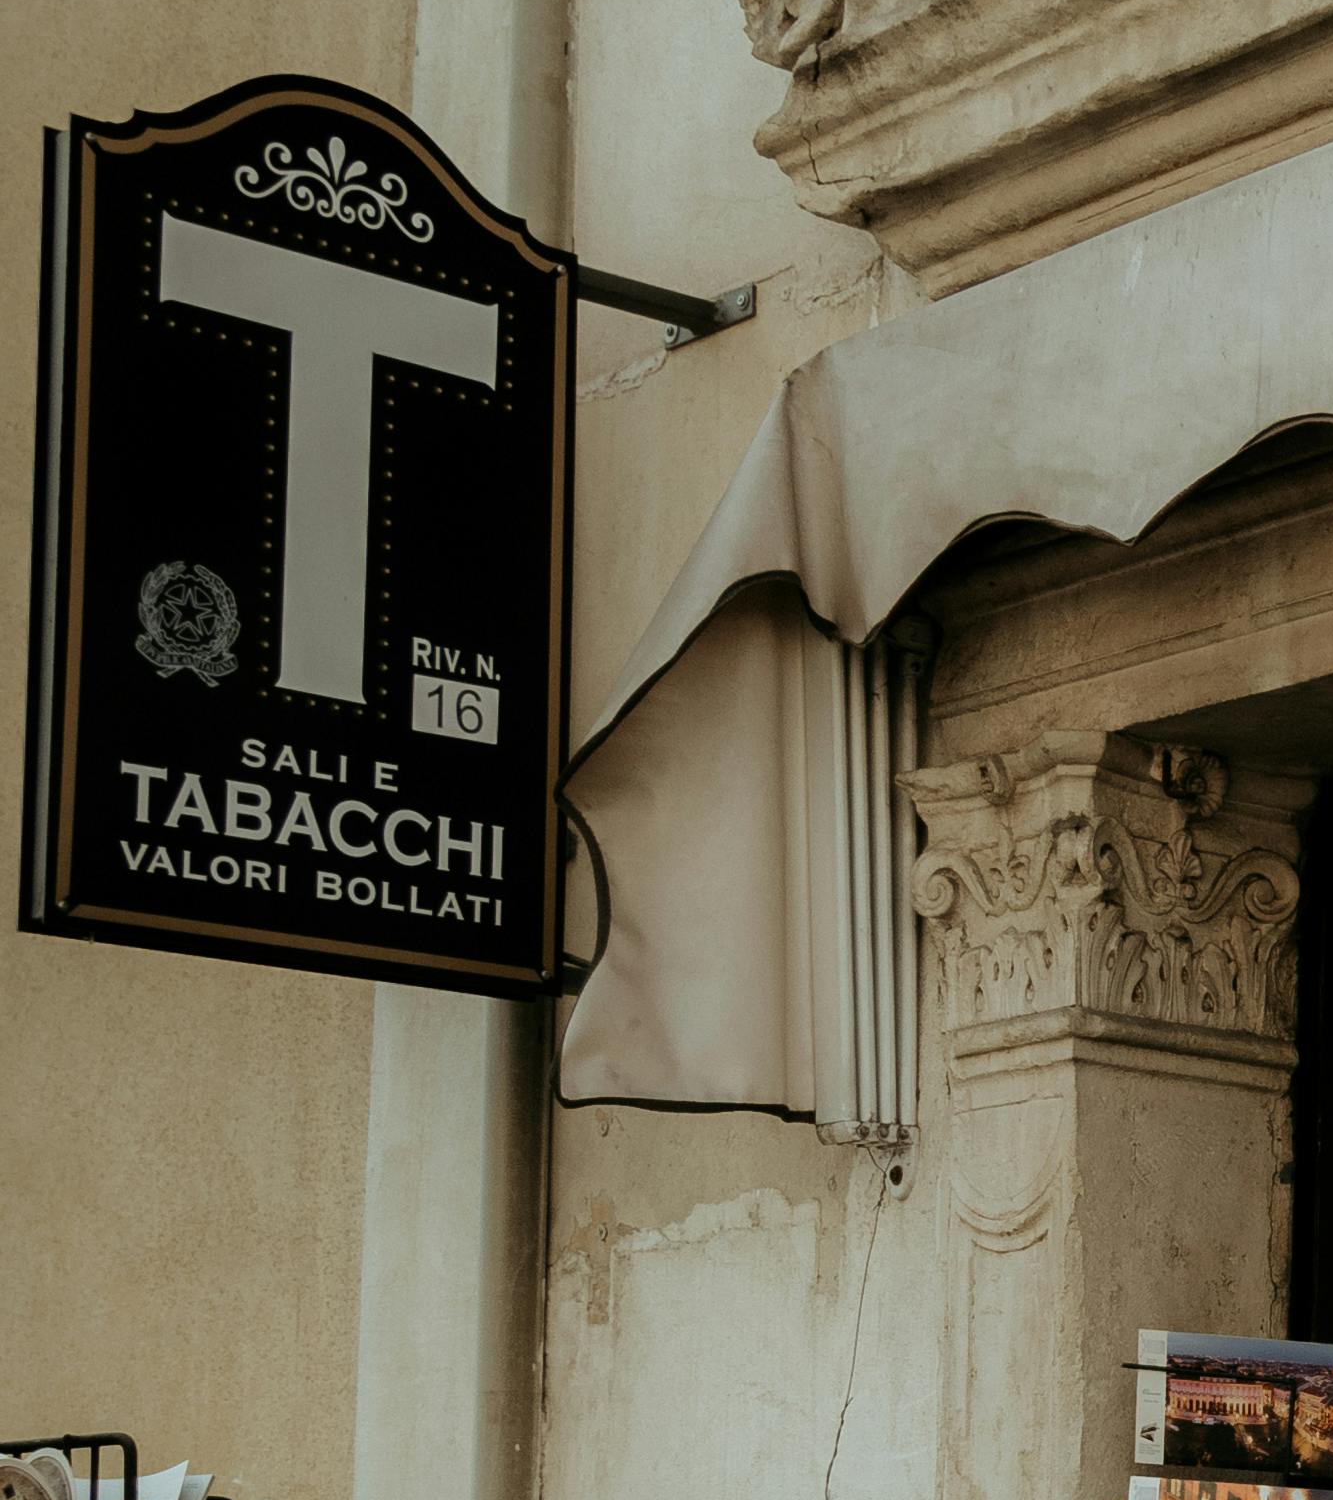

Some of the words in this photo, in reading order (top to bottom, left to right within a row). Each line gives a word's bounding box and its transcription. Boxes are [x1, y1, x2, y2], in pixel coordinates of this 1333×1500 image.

[159, 210, 498, 704] T
[412, 636, 467, 677] RIV.
[475, 649, 502, 681] N.
[426, 684, 485, 735] 16
[241, 738, 348, 784] SALI
[374, 760, 399, 792] E
[120, 761, 505, 880] TABACCHI
[120, 841, 288, 893] VALORI
[316, 871, 502, 926] BOLLATI
